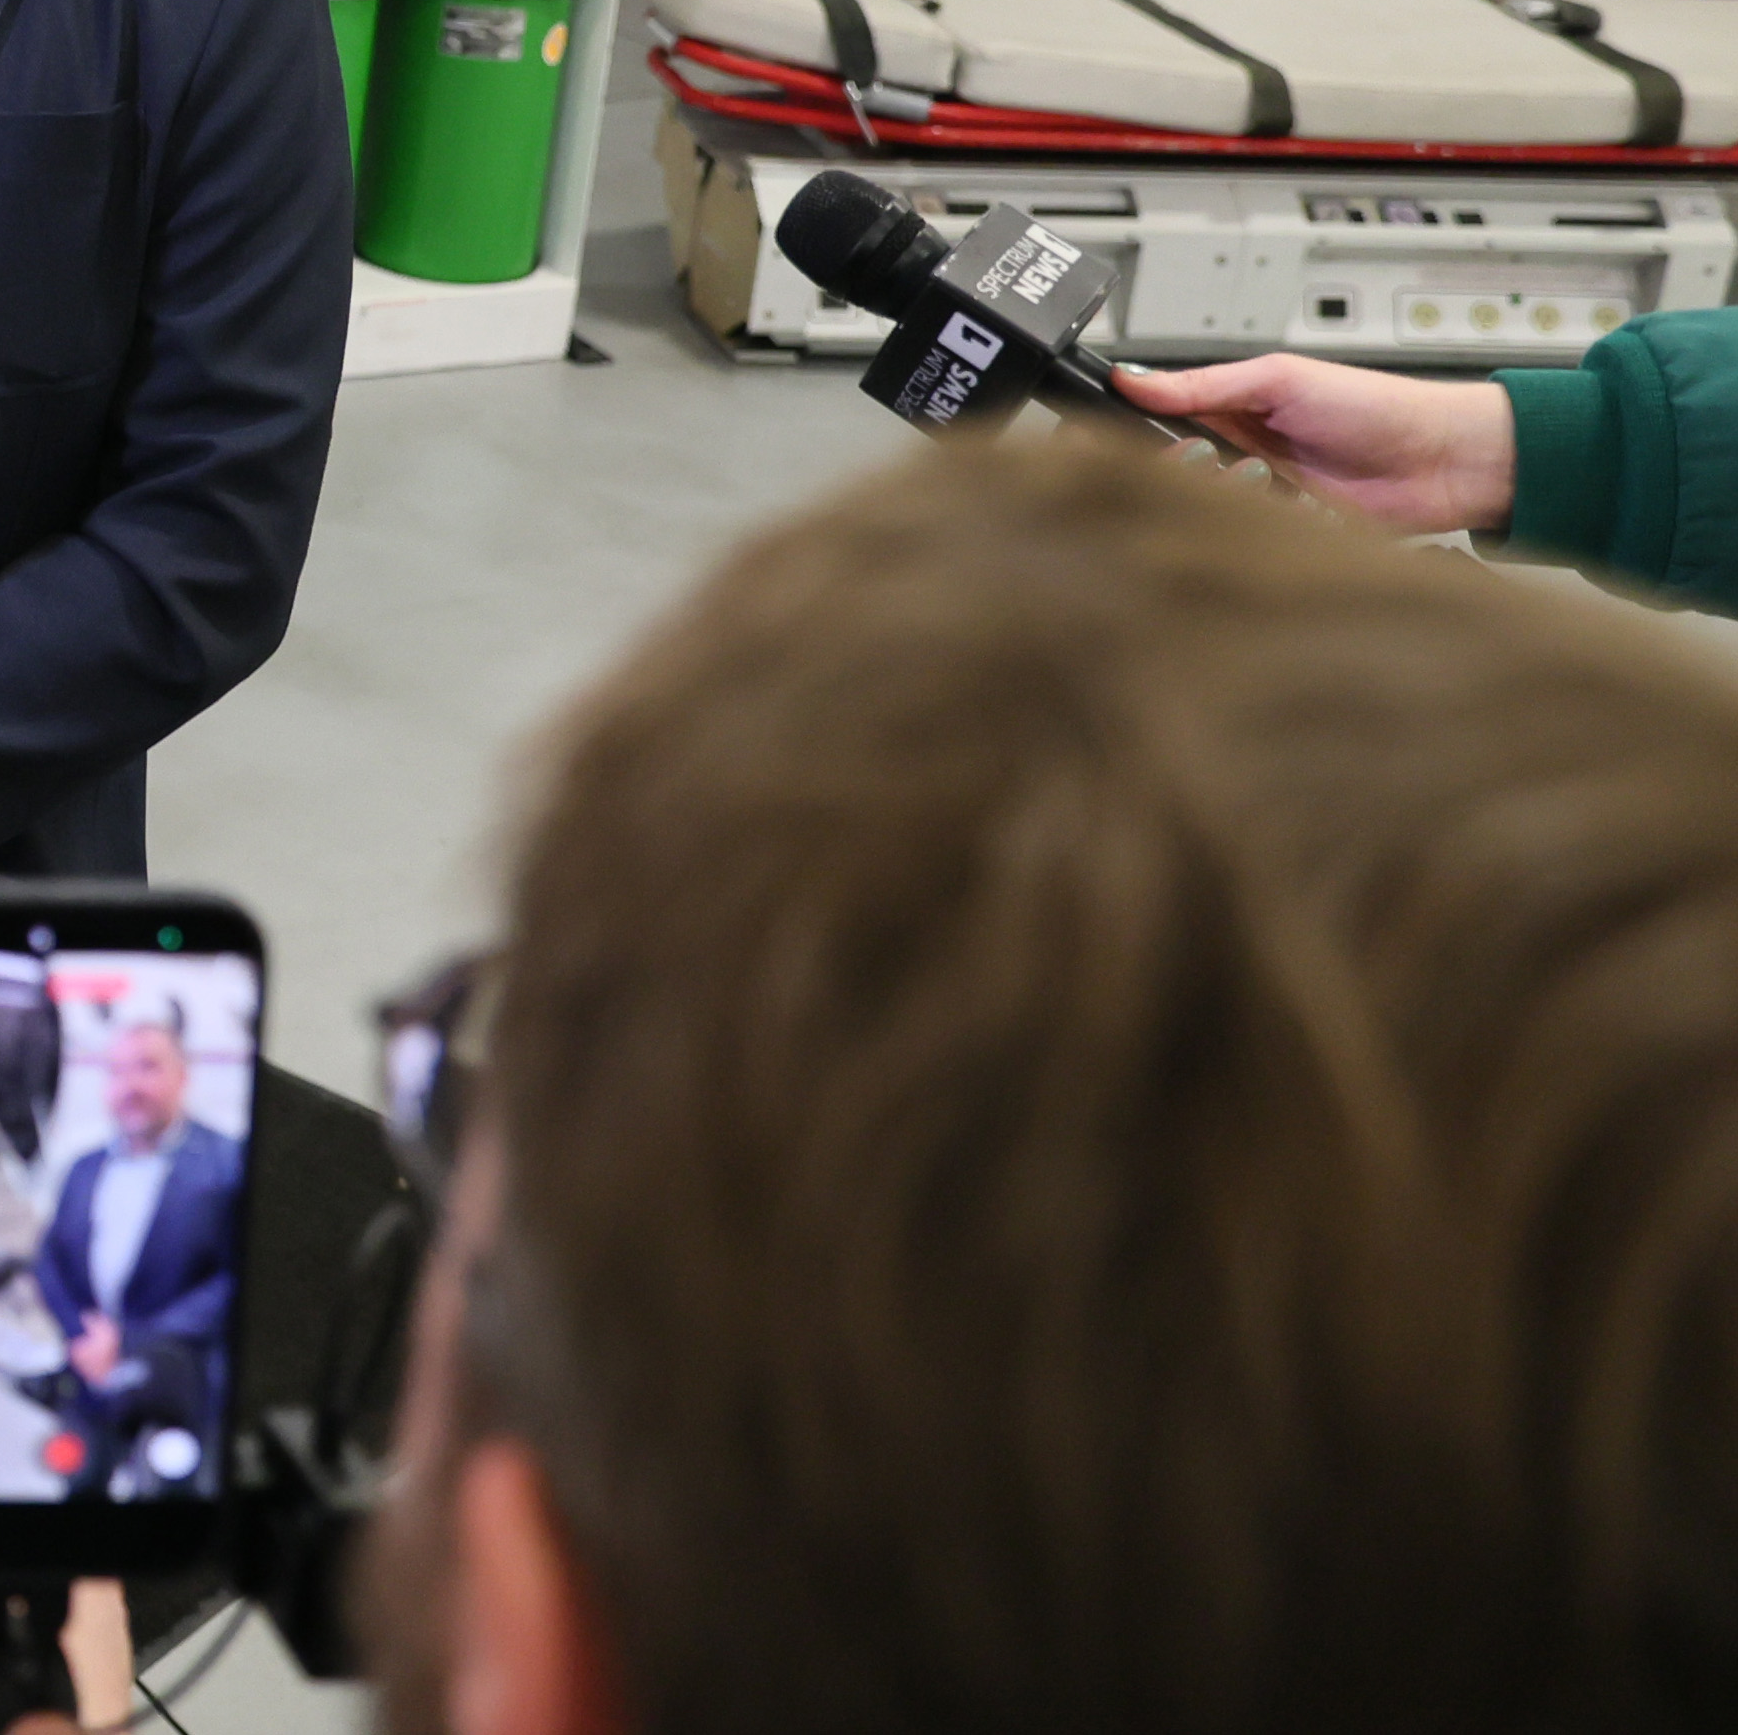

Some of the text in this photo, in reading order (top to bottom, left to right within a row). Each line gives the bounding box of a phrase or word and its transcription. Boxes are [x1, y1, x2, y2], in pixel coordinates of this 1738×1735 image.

[976, 235, 1041, 300] SPECTRUM
[1011, 250, 1070, 306] NEWS
[894, 346, 950, 419] SPECTRUM
[923, 361, 979, 427] NEWS
